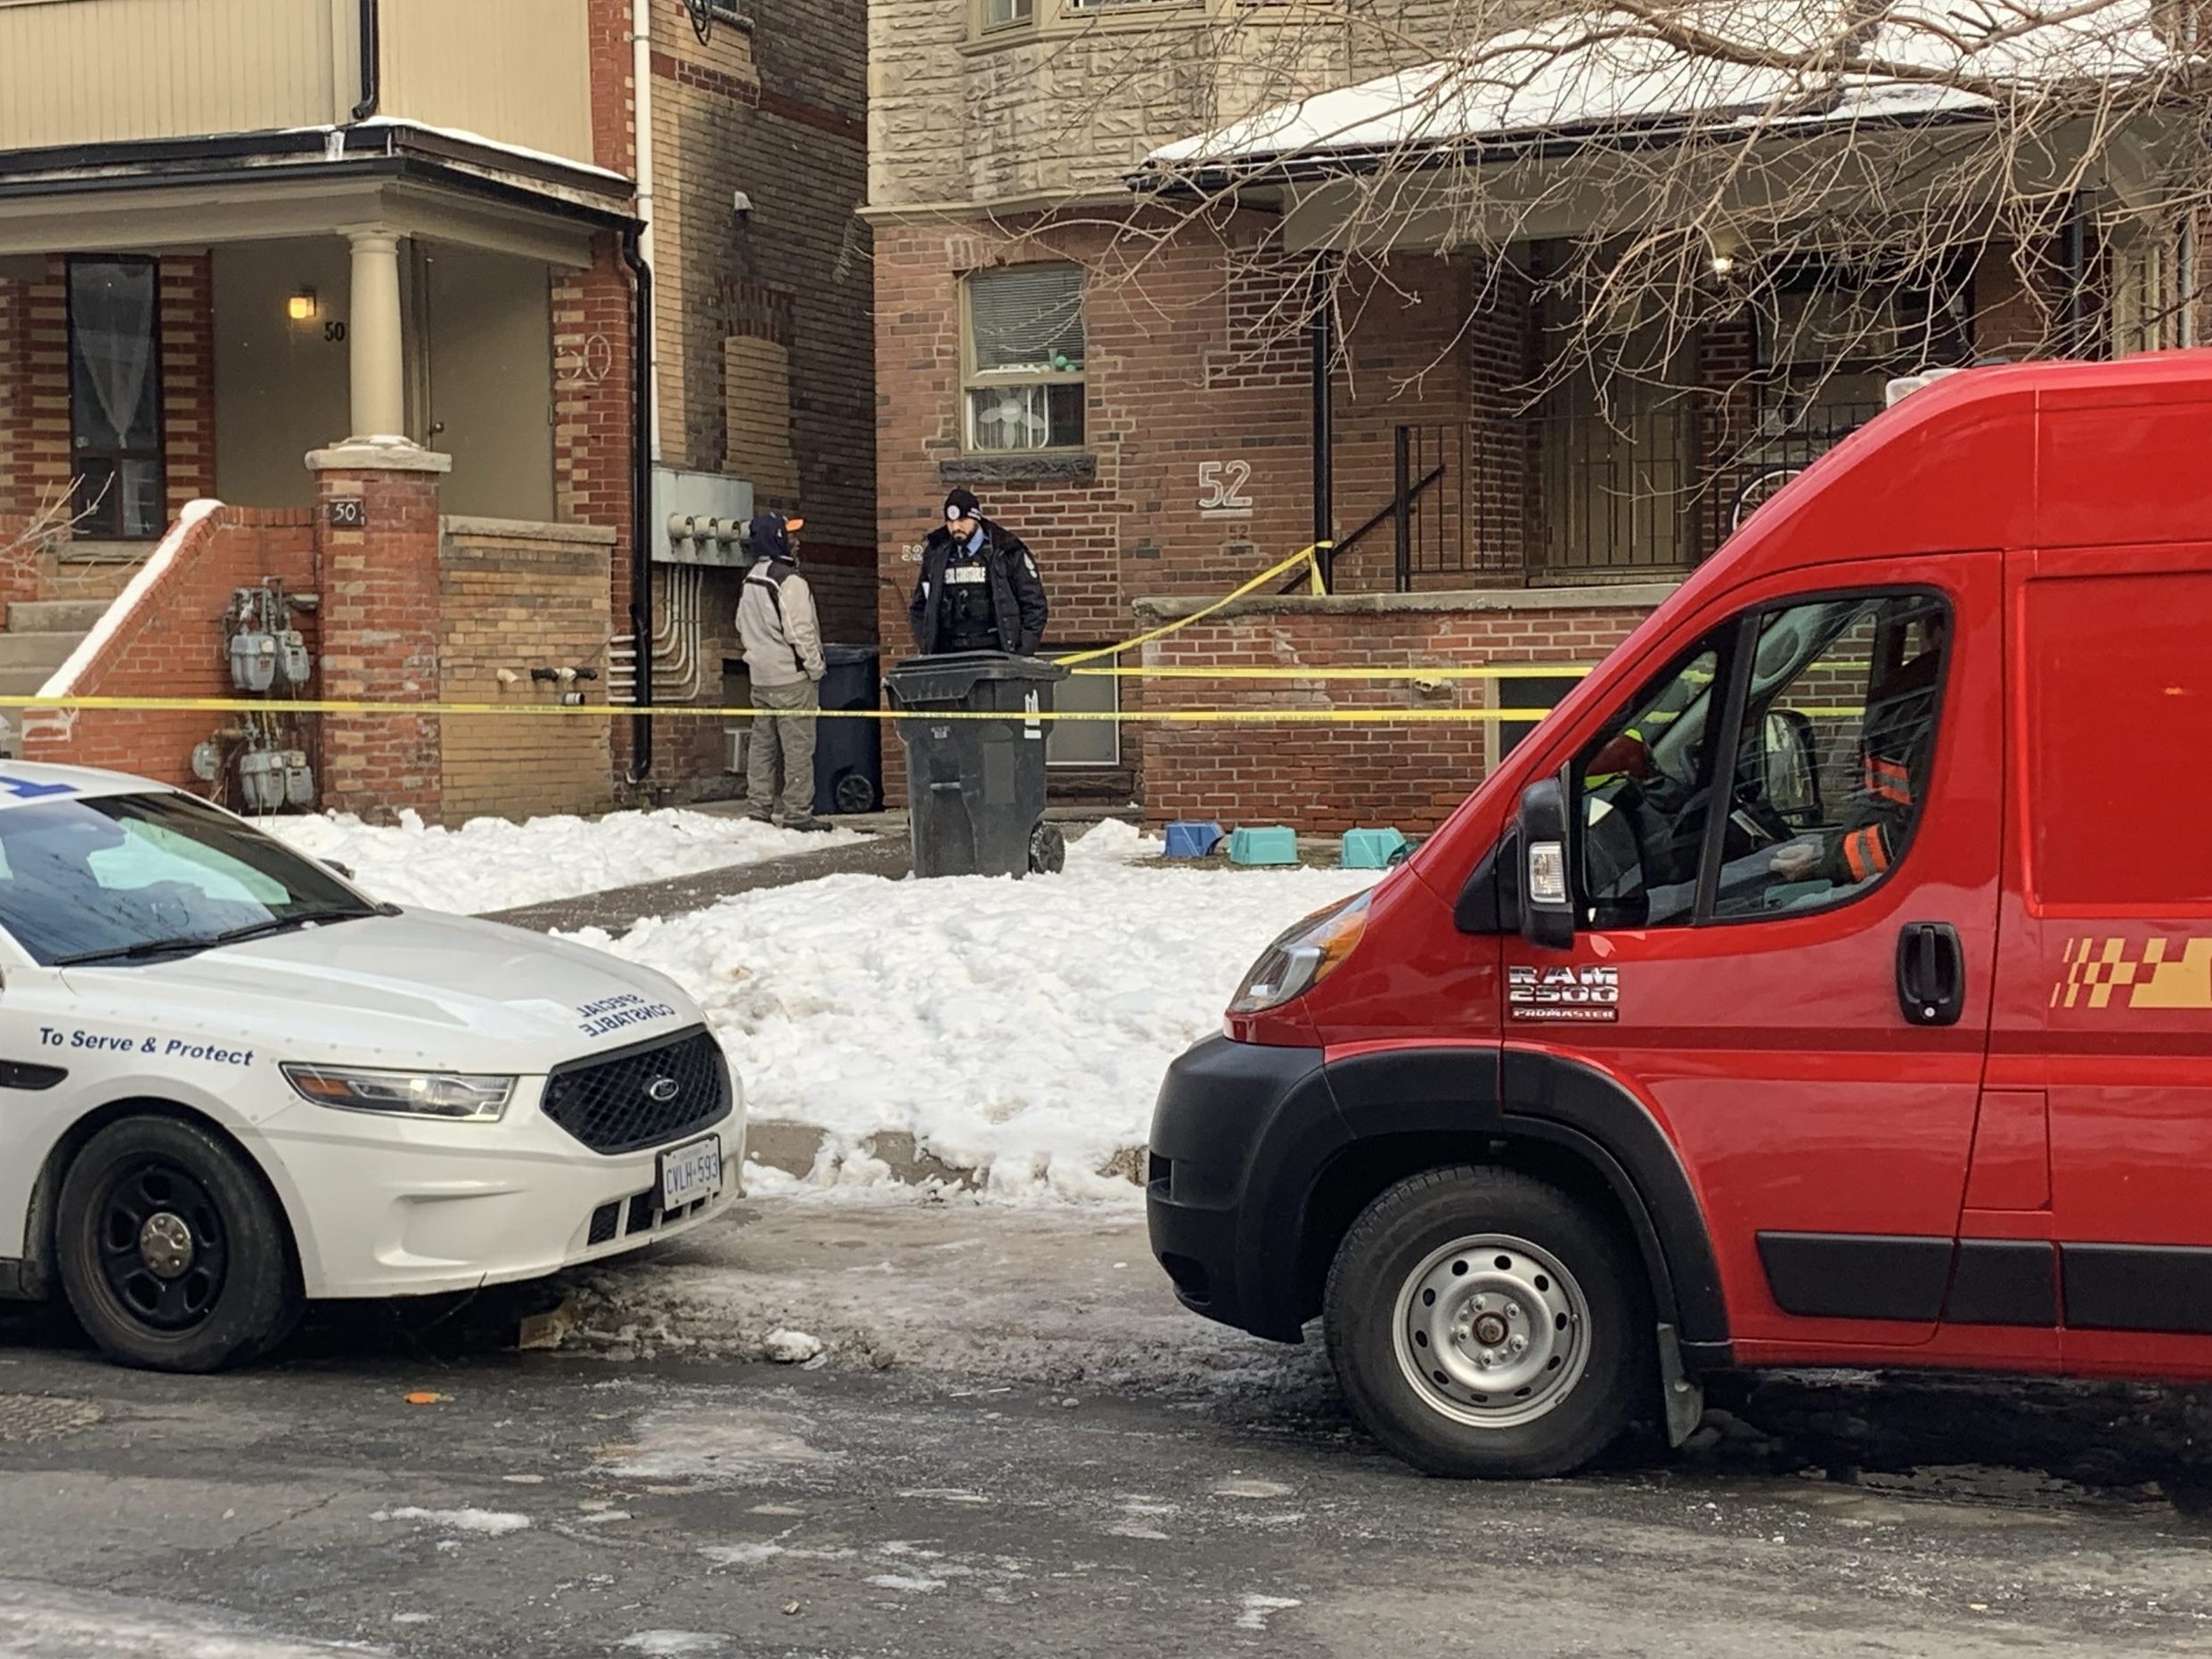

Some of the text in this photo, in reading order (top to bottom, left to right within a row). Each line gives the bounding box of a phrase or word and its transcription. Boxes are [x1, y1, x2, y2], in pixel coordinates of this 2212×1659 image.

[324, 321, 346, 342] 50
[1198, 459, 1253, 508] 52
[334, 503, 356, 521] 50
[902, 544, 924, 562] 52
[1509, 966, 1619, 984] RAM
[1509, 985, 1620, 1002] 2500
[1513, 1007, 1615, 1019] PROMASTER
[40, 1027, 254, 1066] To Serve & Protect
